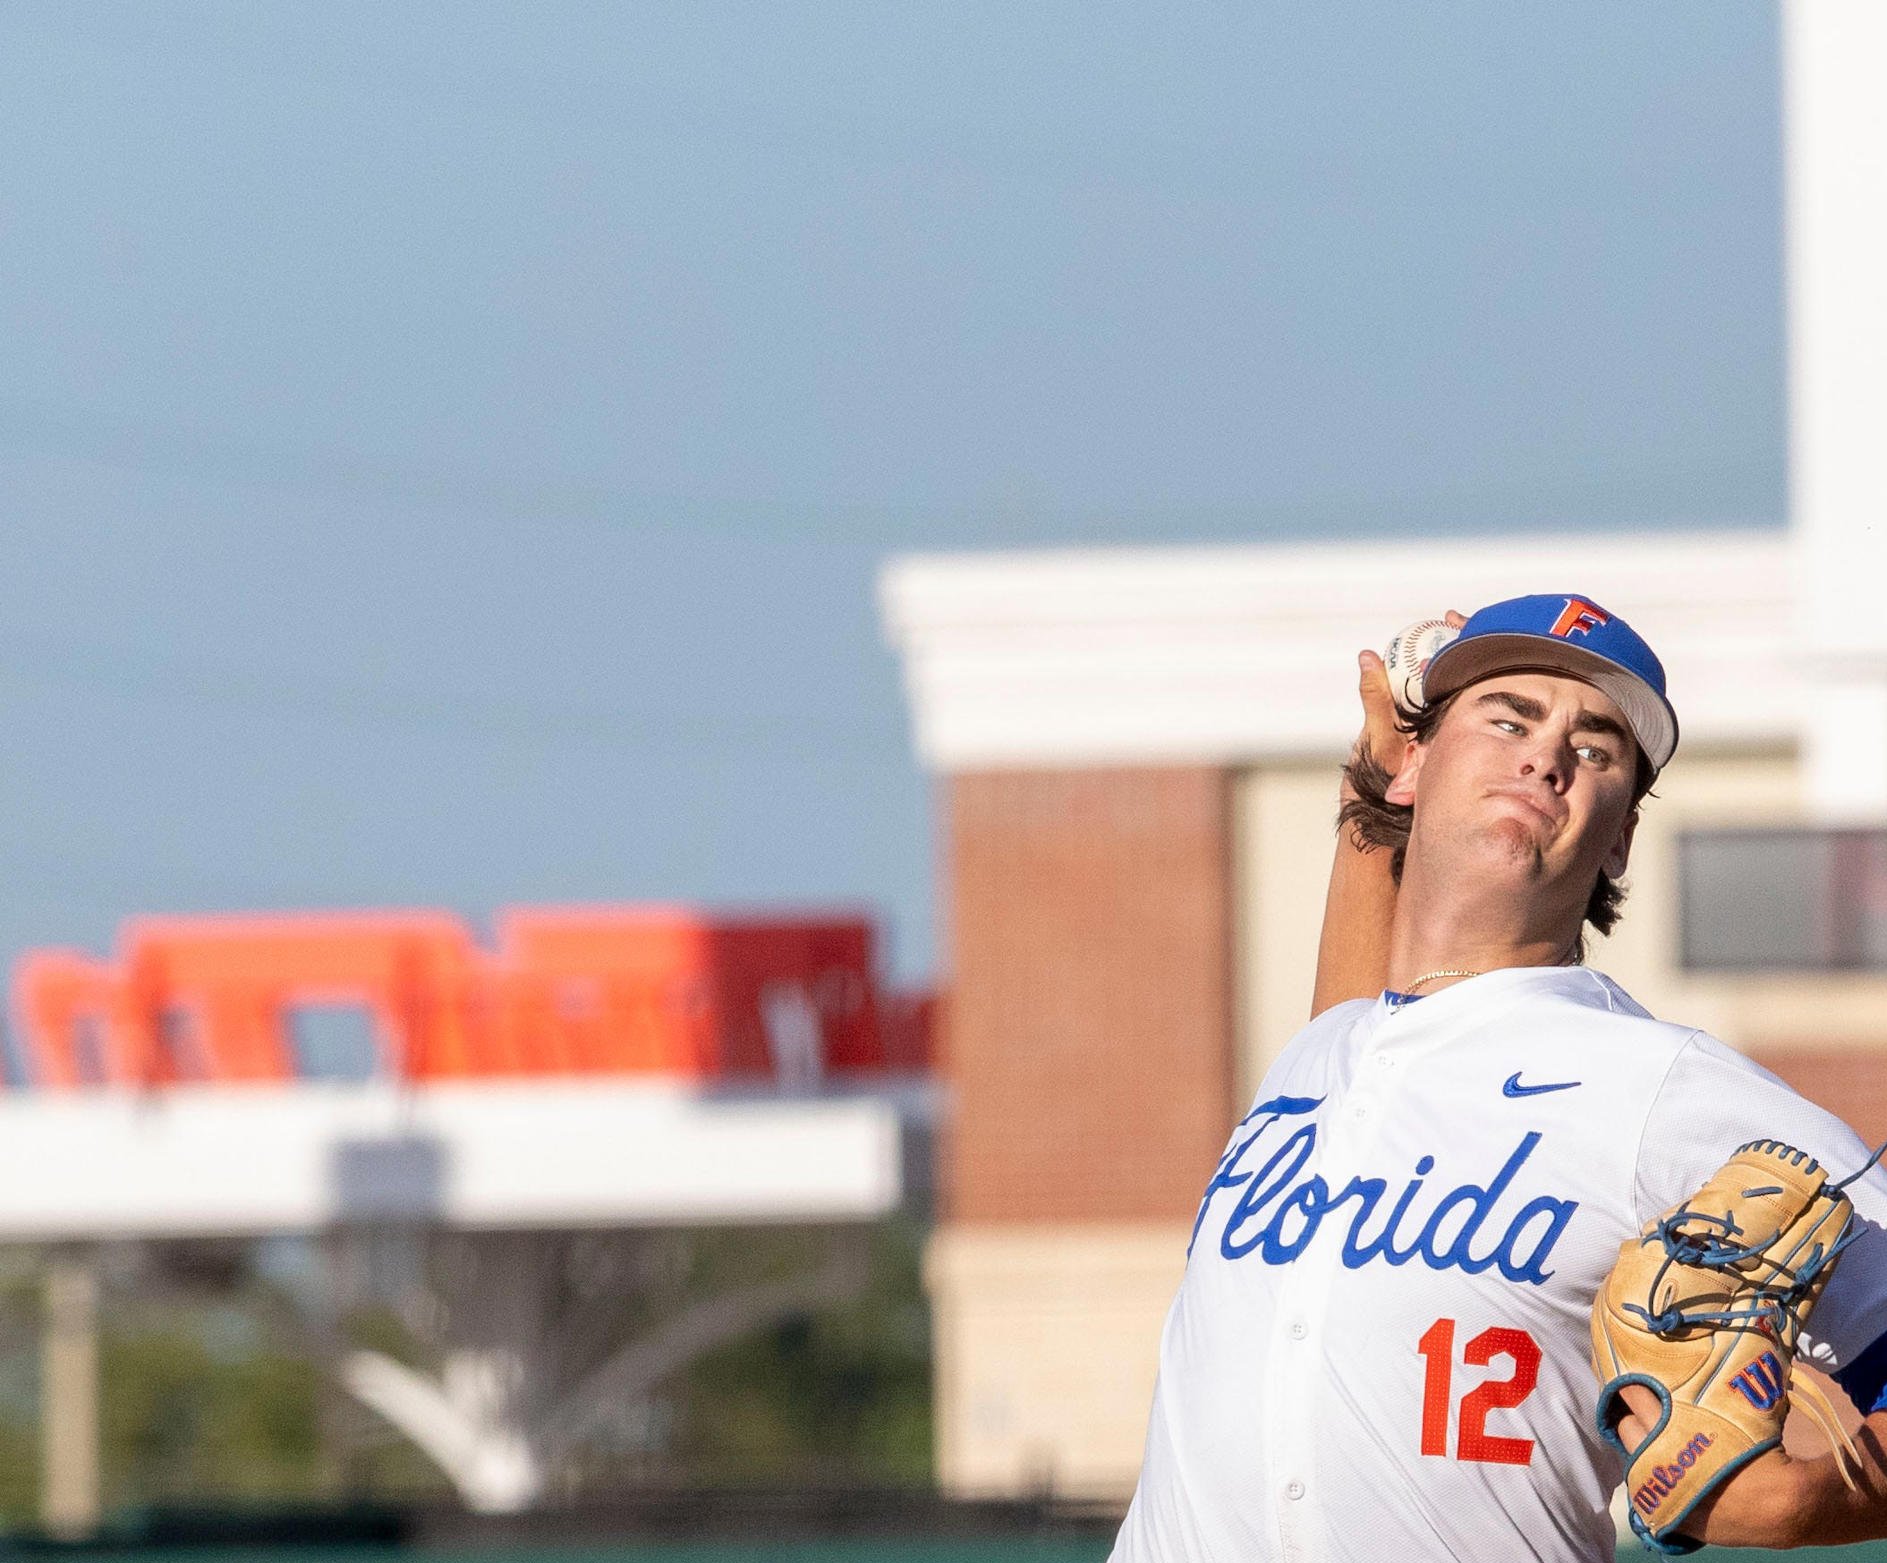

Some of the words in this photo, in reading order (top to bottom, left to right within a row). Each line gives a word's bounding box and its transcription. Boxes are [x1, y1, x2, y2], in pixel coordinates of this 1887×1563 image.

[1549, 598, 1610, 637] F
[1187, 1093, 1579, 1285] Florida
[1418, 1318, 1542, 1466] 12
[1728, 1351, 1785, 1412] W
[1633, 1431, 1714, 1516] Wilson
